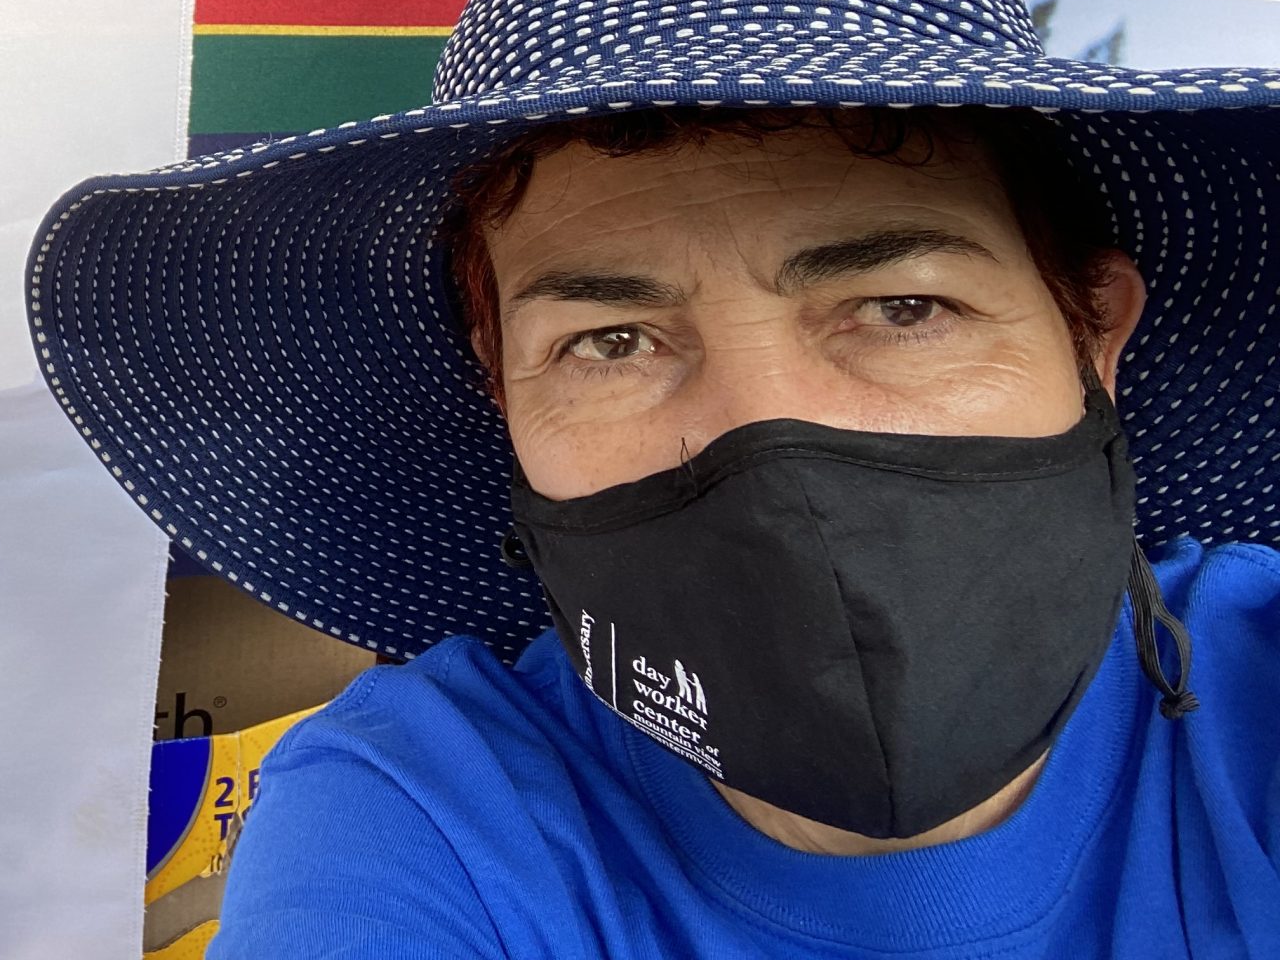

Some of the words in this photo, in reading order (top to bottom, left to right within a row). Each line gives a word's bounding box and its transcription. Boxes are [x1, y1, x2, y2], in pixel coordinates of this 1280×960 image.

[632, 656, 671, 689] day
[633, 679, 708, 730] worker
[633, 700, 701, 744] center
[706, 745, 719, 757] of
[633, 713, 692, 749] mountain
[694, 745, 721, 767] view
